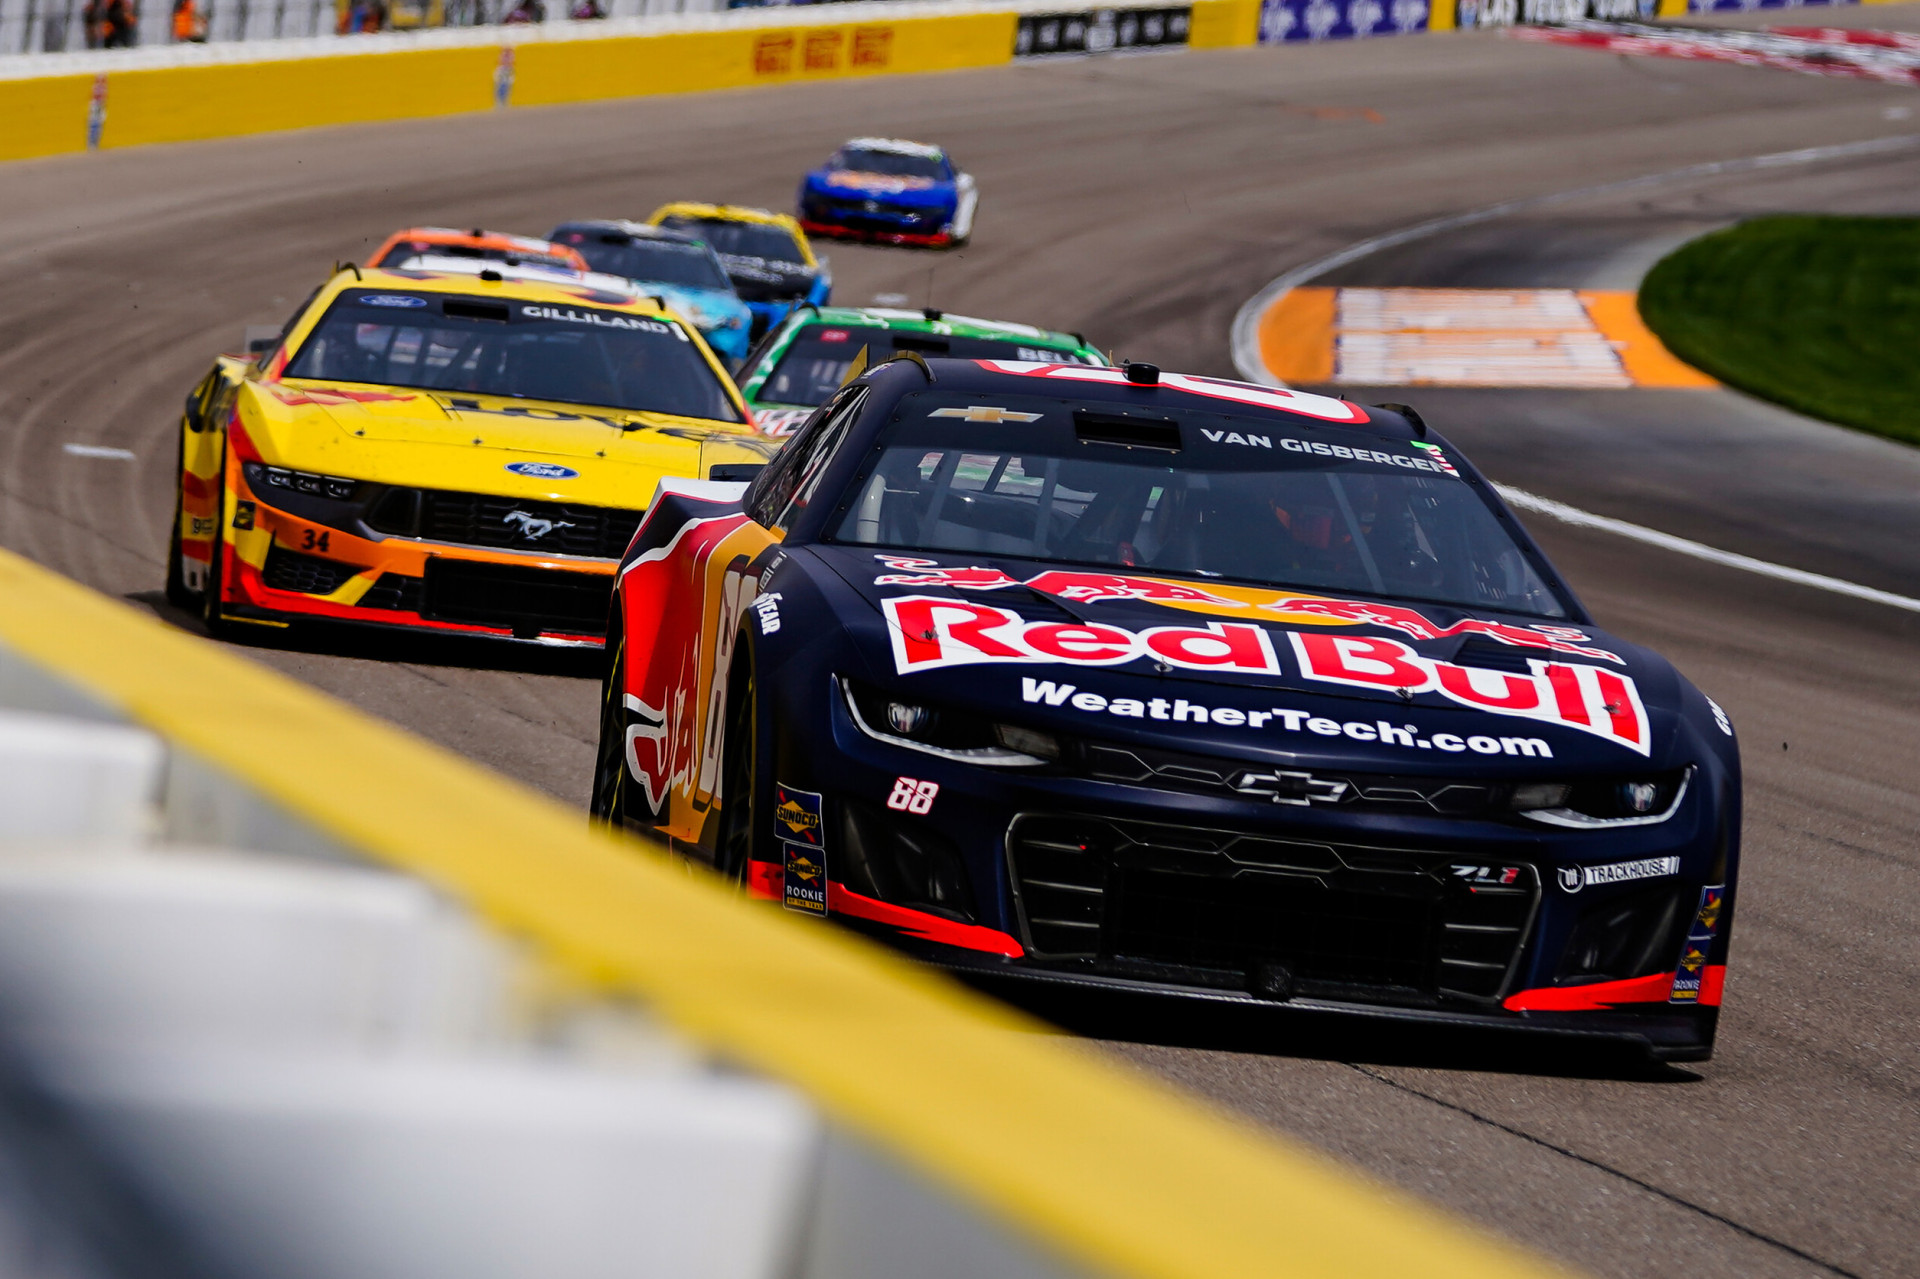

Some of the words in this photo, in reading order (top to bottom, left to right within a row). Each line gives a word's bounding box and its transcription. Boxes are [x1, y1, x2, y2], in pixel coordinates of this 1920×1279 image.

[521, 305, 670, 334] GILLILAND
[1200, 428, 1273, 449] VAN
[302, 529, 331, 552] 34
[882, 595, 1280, 675] Red
[1288, 631, 1651, 758] Bull
[887, 777, 939, 815] 88
[776, 805, 819, 828] SUNOCO
[1450, 864, 1520, 884] ZL1
[1590, 859, 1667, 884] TRACKHOUSE
[786, 885, 824, 902] ROOKIE
